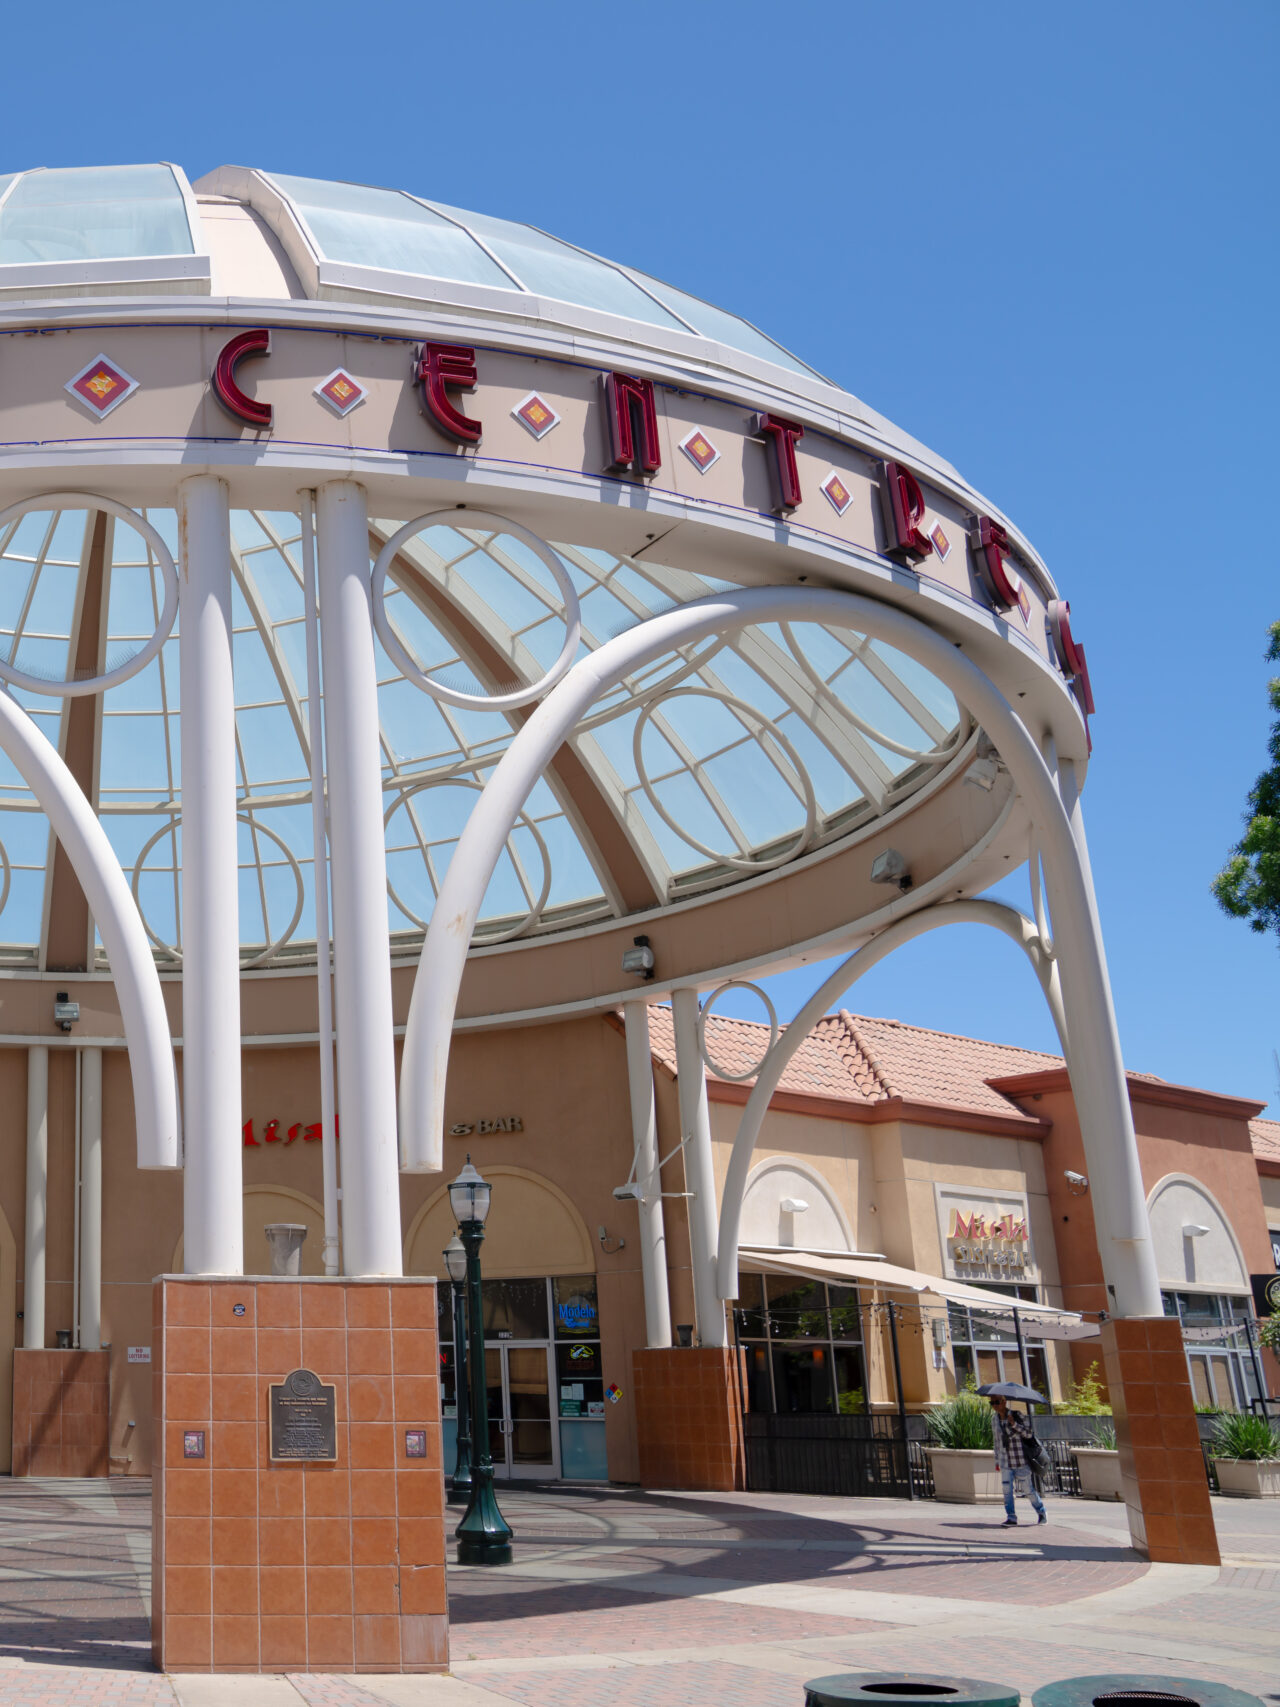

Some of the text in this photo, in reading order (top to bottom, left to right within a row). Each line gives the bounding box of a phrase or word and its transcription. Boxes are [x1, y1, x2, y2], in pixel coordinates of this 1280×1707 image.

[211, 329, 1020, 613] CENTRE
[477, 1116, 524, 1135] BAR
[954, 1208, 1029, 1241] Misaki
[558, 1303, 596, 1320] Modelo
